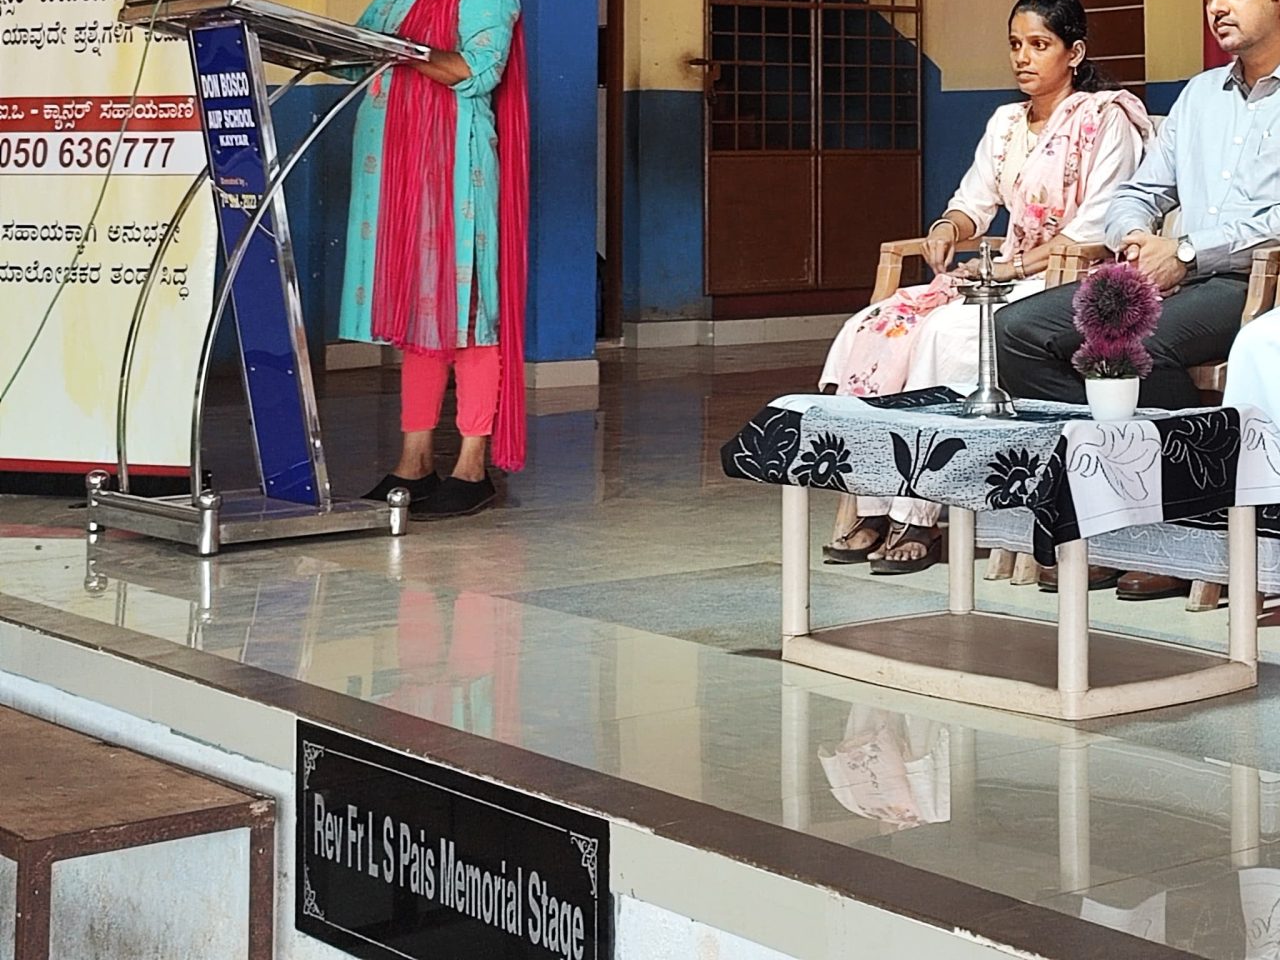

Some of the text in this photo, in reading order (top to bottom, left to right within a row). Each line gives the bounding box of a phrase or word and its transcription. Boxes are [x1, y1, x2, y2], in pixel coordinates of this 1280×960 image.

[1, 21, 67, 50] ಯಾವುದೇ
[200, 71, 249, 99] DON BOSCO
[43, 100, 93, 130] ಕ್ಯಾನ್ಸರ್
[99, 97, 195, 120] ಸಹಾಯವಾಣಿ
[223, 108, 256, 129] SCHOOL
[0, 137, 175, 168] 050 636 777
[219, 134, 249, 147] KAYYAR
[2, 219, 97, 255] ಸಹಾಯಕ್ಕಾಗಿ
[110, 262, 152, 284] ತಂಡ
[314, 793, 584, 960] Rev Fr L S Pais Memorial Stage
